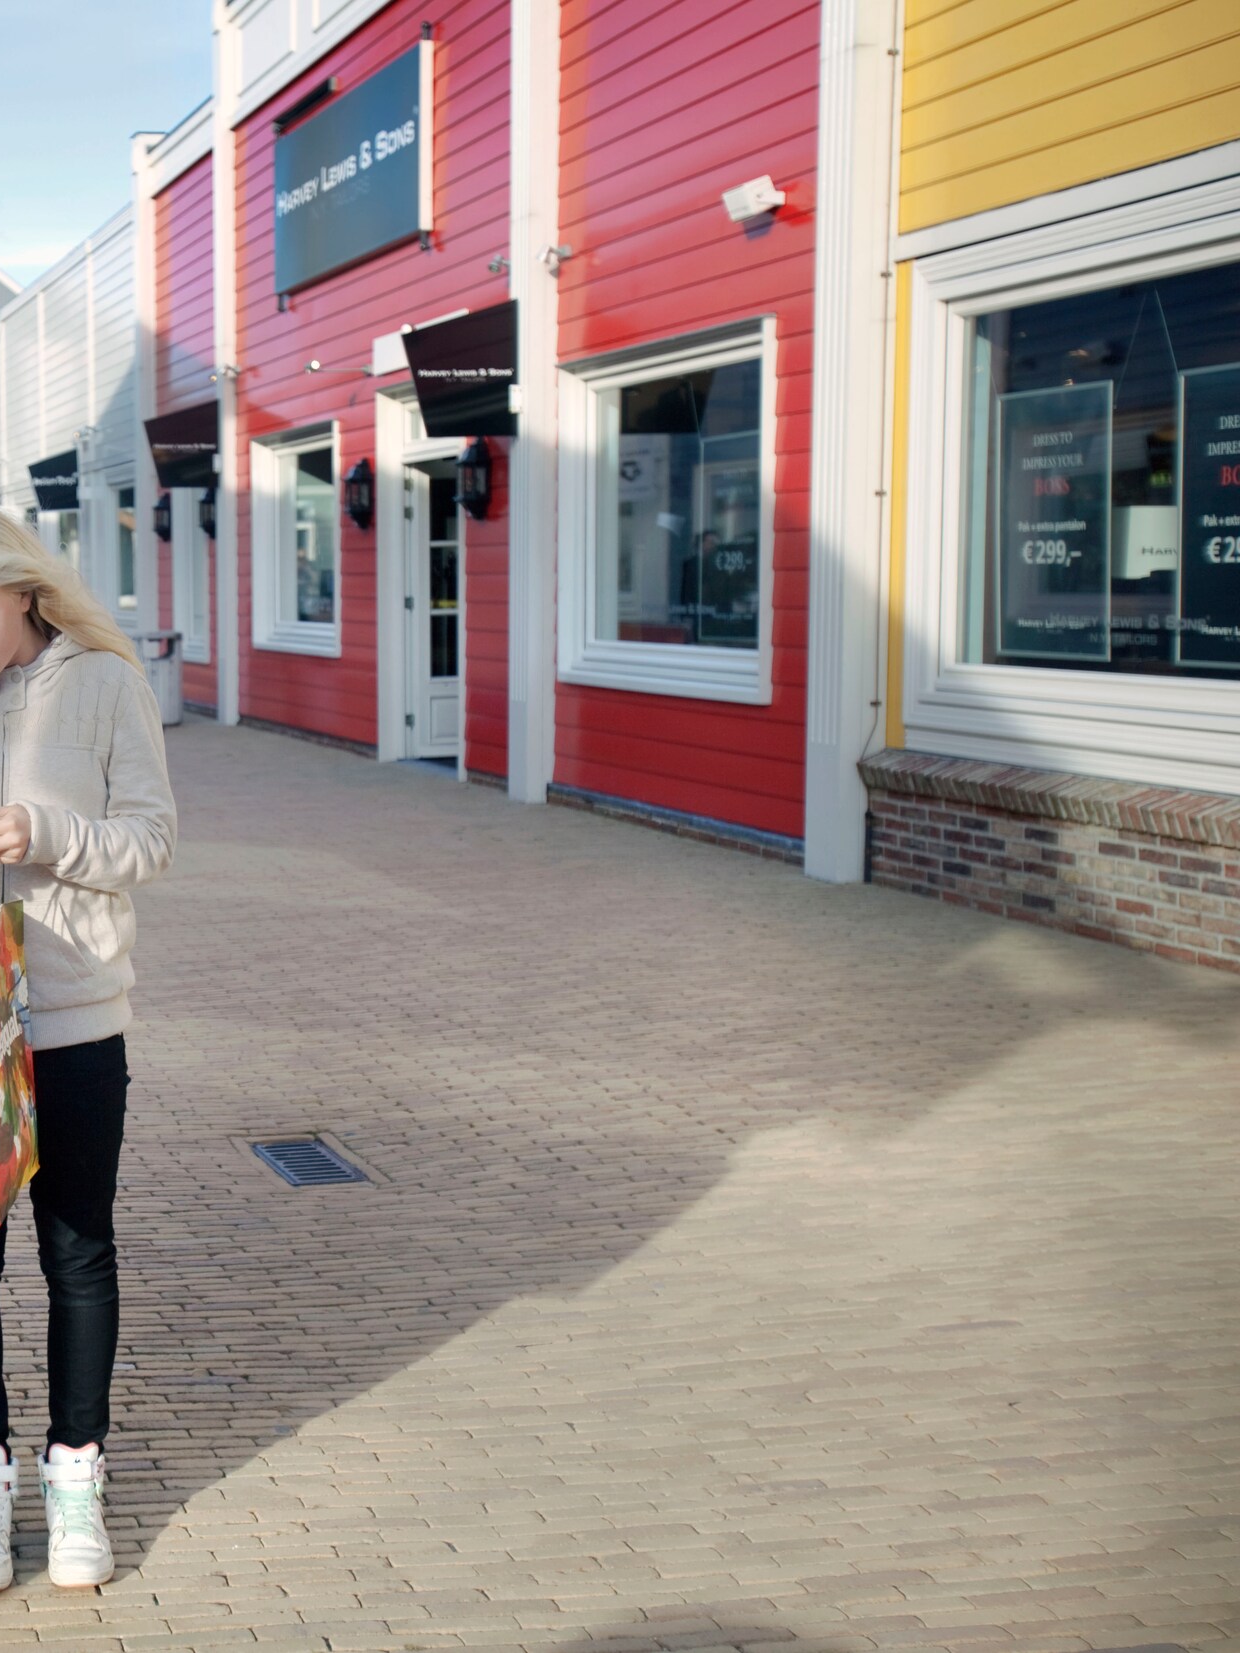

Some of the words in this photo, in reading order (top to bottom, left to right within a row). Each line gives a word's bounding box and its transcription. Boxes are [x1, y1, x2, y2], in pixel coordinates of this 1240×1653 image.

[276, 176, 319, 217] HARVEY
[321, 154, 357, 192] LEWIS
[359, 139, 373, 170] &
[374, 119, 416, 161] SONS
[1033, 432, 1059, 447] DRESS
[1060, 431, 1073, 445] TO
[1023, 455, 1057, 470] IMPRESS
[1057, 453, 1084, 468] YOUR
[1034, 476, 1070, 496] BOSS
[1055, 519, 1087, 533] pantalon
[1148, 613, 1159, 630] &
